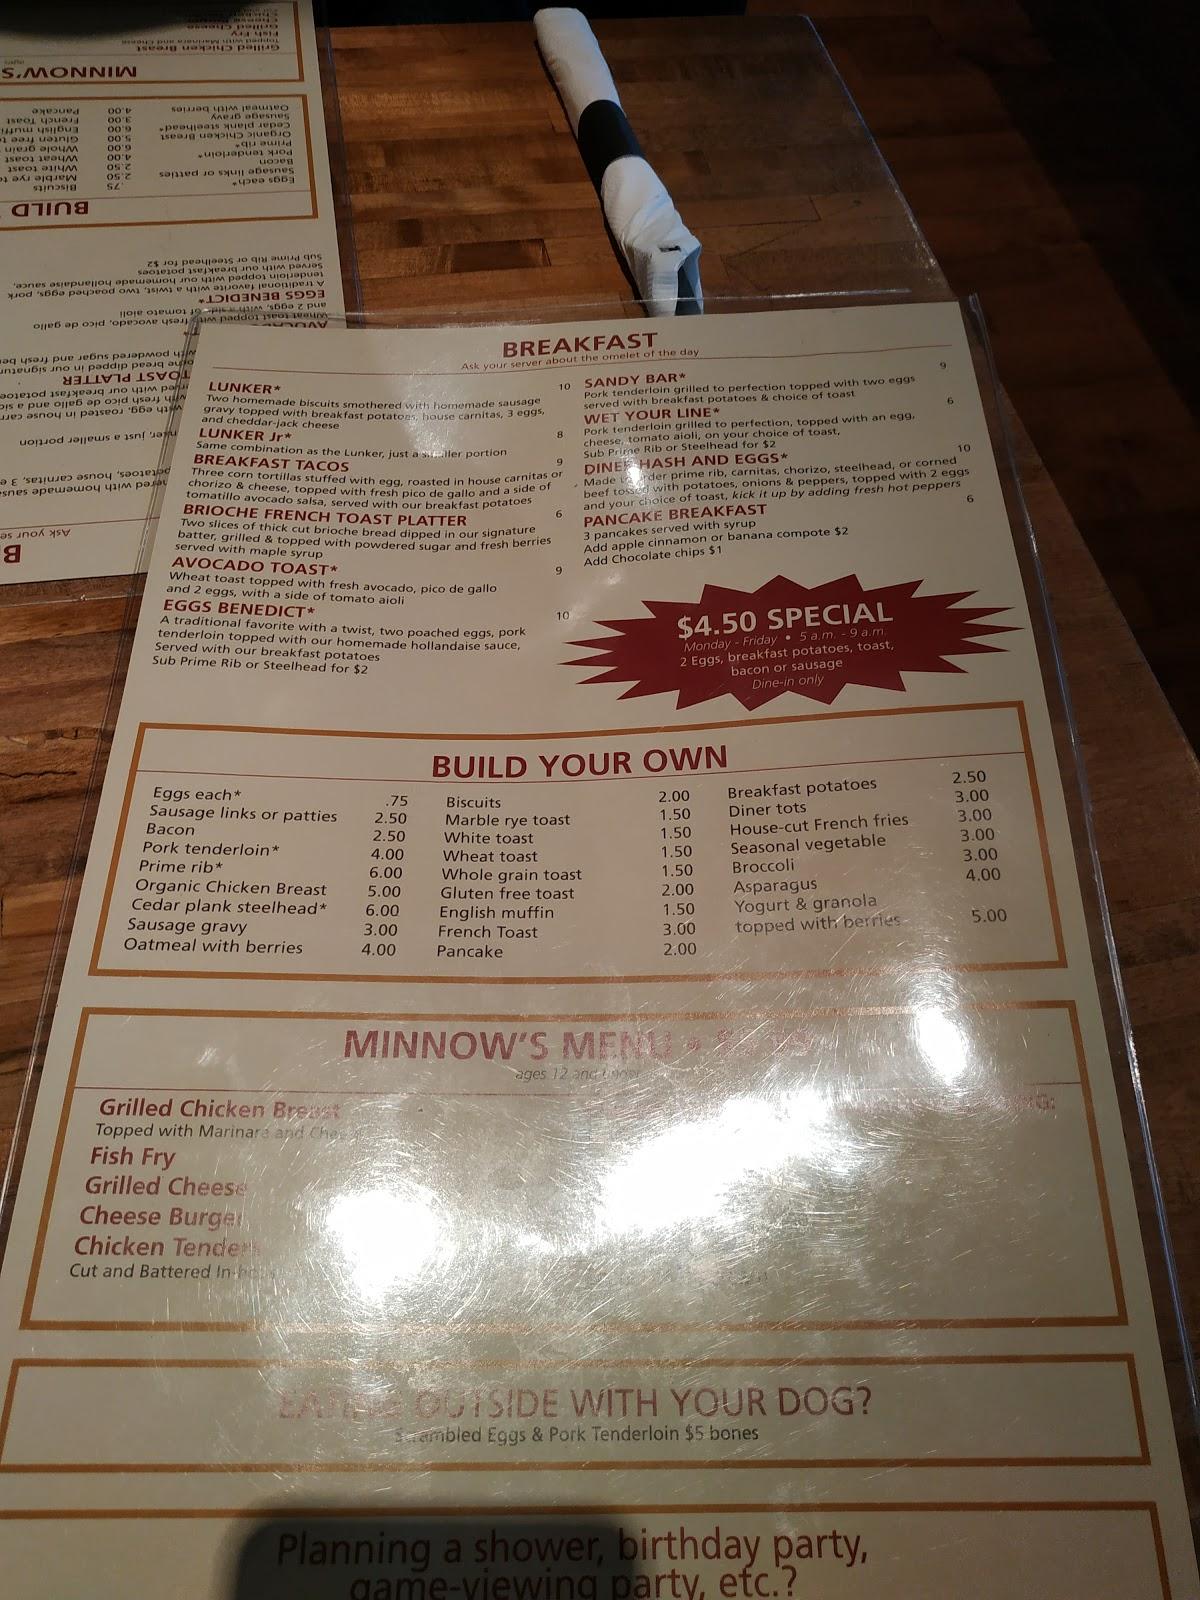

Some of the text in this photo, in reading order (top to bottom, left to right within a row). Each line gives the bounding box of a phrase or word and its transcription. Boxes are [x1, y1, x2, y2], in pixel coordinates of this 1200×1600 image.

[2, 66, 137, 79] MINNOW'S
[107, 163, 131, 171] 2.50
[33, 184, 76, 192] Biscuits
[11, 201, 88, 217] BUILD
[285, 290, 325, 300] EGGS
[503, 332, 658, 358] BREAKFAST
[461, 362, 479, 370] Ask
[484, 363, 507, 371] your
[511, 360, 542, 368] server
[546, 356, 576, 365] about
[581, 354, 598, 362] the
[602, 352, 639, 360] omelet
[680, 348, 699, 357] day
[63, 373, 131, 385] PLATTER
[585, 375, 639, 388] SANDY
[584, 413, 619, 424] WET
[625, 409, 671, 421] YOUR
[199, 428, 264, 441] LUNKER
[194, 454, 349, 472] BREAKFAST TACOS
[557, 458, 563, 466] 9
[967, 495, 974, 503] 6
[183, 504, 466, 526] BRIOCHE FRENCH TOAST PLATTER
[556, 510, 562, 518] 6
[584, 504, 767, 528] PANCAKE BREAKFAST
[17, 528, 71, 538] Ask your
[584, 521, 756, 541] 3 pancakes served with syrup
[172, 557, 264, 572] AVOCADO
[555, 566, 562, 575] 9
[164, 599, 211, 613] EGGS
[557, 611, 569, 620] 10
[678, 602, 893, 641] $4.50 SPECIAL
[680, 641, 894, 667] 2 Eggs, breakfast potatoes, toast,
[152, 655, 176, 665] Sub
[180, 656, 216, 667] Prime
[221, 658, 241, 668] Rib
[264, 660, 326, 672] Steelhead
[331, 663, 349, 673] for
[354, 664, 368, 675] $2
[731, 660, 843, 676] bacon or sausage
[752, 674, 824, 689] Dine-in only
[433, 745, 727, 778] BUILD YOUR OWN
[953, 770, 986, 784] 2.50
[154, 787, 190, 802] Eggs
[659, 790, 690, 803] 2.00
[728, 780, 877, 799] Breakfast potatoes
[386, 795, 408, 806] .75
[447, 796, 501, 808] Biscuits
[150, 805, 337, 823] Sausage links or patties
[729, 803, 806, 817] Diner tots
[375, 812, 407, 824] 2.50
[146, 822, 195, 835] Bacon
[373, 830, 405, 842] 2.50
[371, 848, 404, 861] 4.00
[733, 858, 794, 874] Broccoli
[136, 879, 327, 896] Organic Chicken Breast
[368, 885, 401, 898] 5.00
[124, 937, 302, 954] Oatmeal with berries
[361, 943, 396, 956] 4.00
[437, 945, 503, 958] Pancake
[664, 942, 696, 956] 2.00
[344, 1029, 549, 1061] MINNOW'S
[563, 1031, 671, 1060] MENU
[100, 1098, 173, 1117] Grilled
[180, 1099, 264, 1117] Chicken
[96, 1123, 153, 1140] Topped
[159, 1123, 193, 1138] with
[90, 1146, 176, 1171] Fish Fry
[85, 1175, 247, 1196] Grilled Cheese
[80, 1205, 161, 1225] Cheese
[69, 1263, 210, 1279] Cut and Battered
[415, 1388, 557, 1419] OUTSIDE
[570, 1389, 657, 1417] WITH
[670, 1388, 767, 1417] YOUR
[779, 1387, 872, 1417] DOG?
[488, 1424, 759, 1447] Eggs & Pork Tenderloin $5 bones
[278, 1528, 868, 1571] Planning a shower, birthday party,
[350, 1567, 797, 1600] game-viewing party, etc.?
